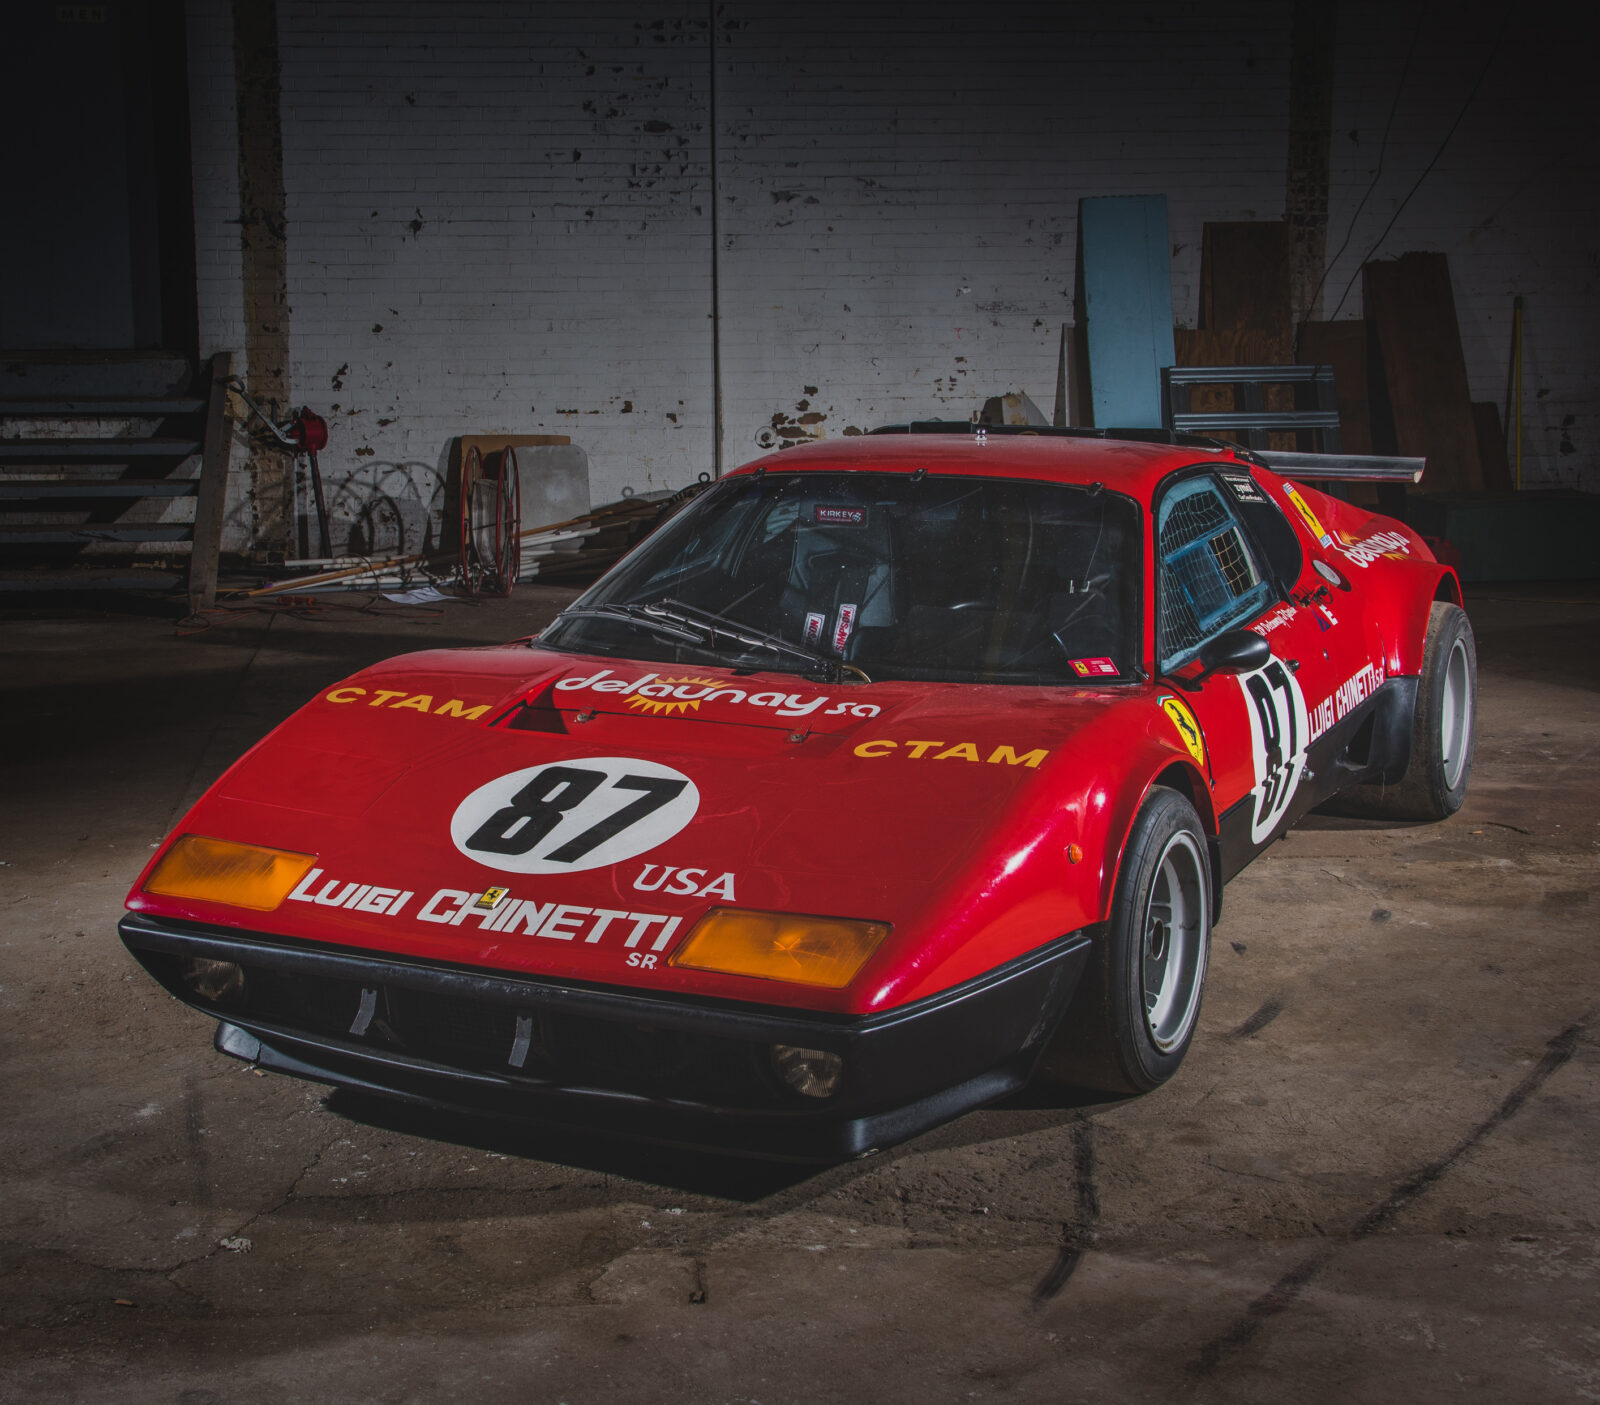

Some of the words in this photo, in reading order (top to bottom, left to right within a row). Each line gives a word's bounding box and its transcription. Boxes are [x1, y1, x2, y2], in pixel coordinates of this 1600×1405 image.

[62, 9, 101, 20] MEN
[820, 509, 854, 518] KIRKEY
[555, 670, 829, 716] delaunay
[1309, 695, 1335, 743] LUIGI
[1336, 662, 1376, 720] CHINETTI
[1245, 660, 1298, 828] 87
[465, 766, 690, 863] 87
[288, 868, 413, 916] LUIGI
[416, 888, 683, 951] CHINETTI
[632, 864, 736, 901] USA
